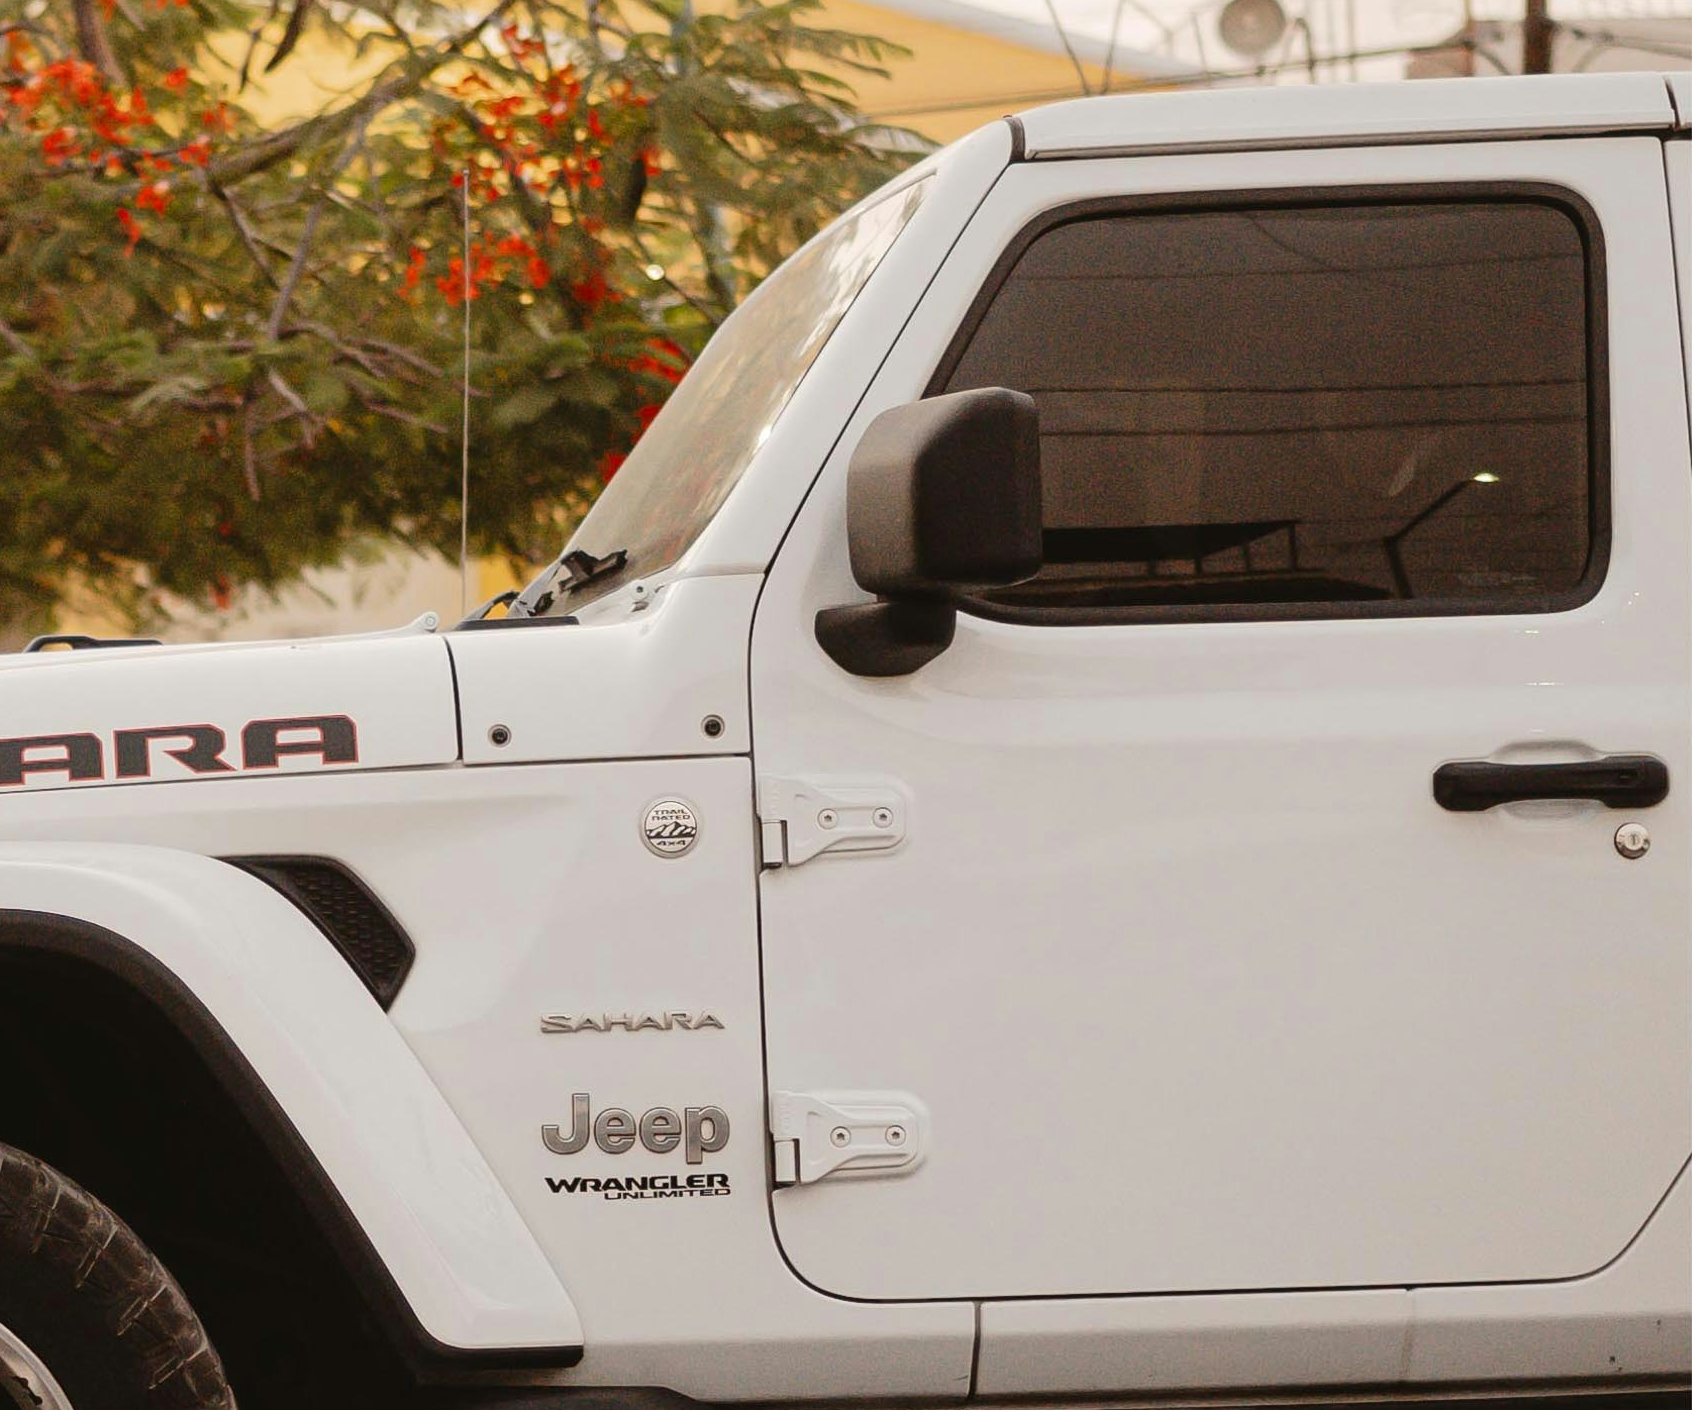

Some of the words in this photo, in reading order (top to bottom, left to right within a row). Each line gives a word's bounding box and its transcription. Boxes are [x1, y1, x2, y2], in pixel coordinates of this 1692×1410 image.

[540, 1011, 725, 1033] SAHARA
[541, 1092, 730, 1165] Jeep
[544, 1173, 730, 1193] WRANGLER
[604, 1188, 731, 1200] UNLIMITED
